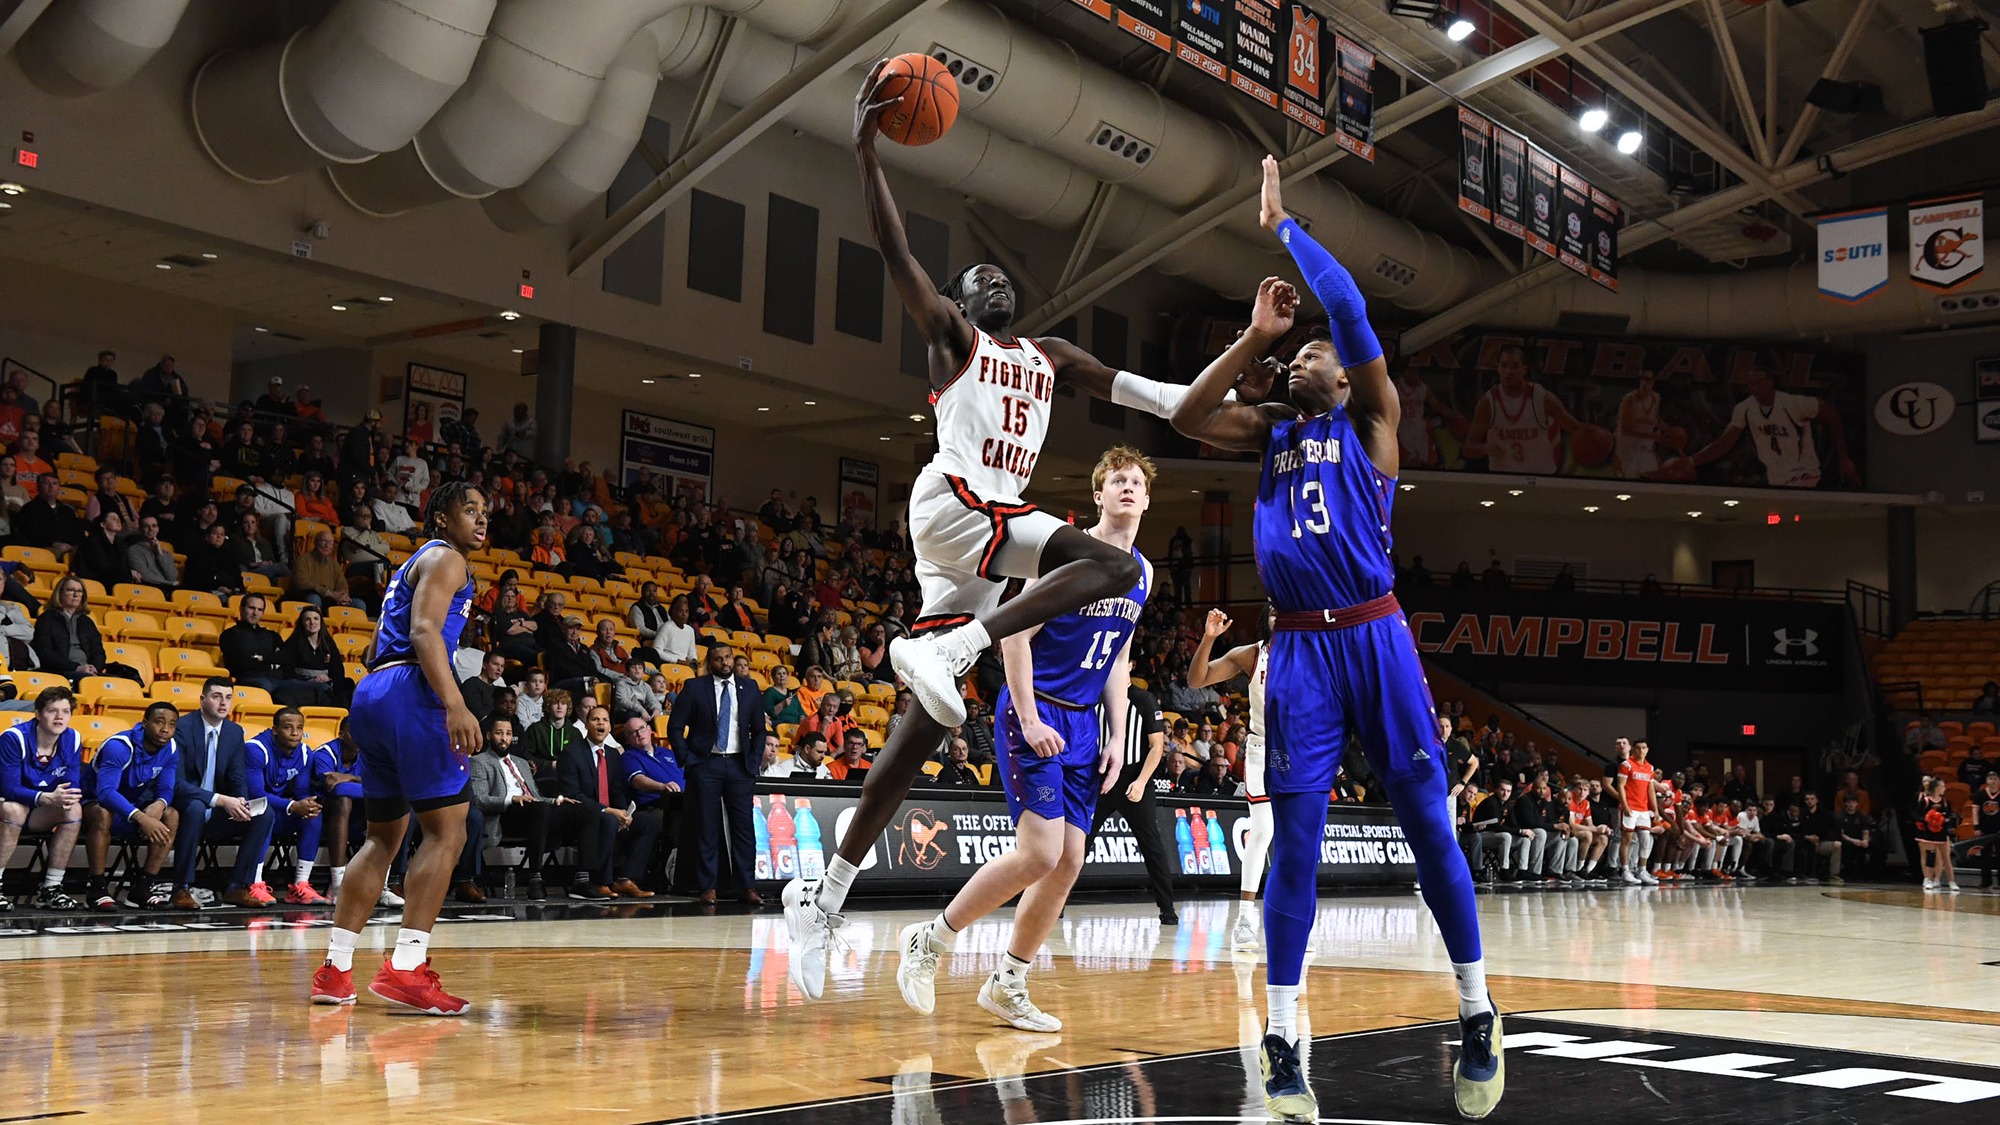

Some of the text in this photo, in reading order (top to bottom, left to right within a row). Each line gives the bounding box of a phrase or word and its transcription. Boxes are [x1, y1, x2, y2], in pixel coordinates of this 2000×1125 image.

[1134, 22, 1156, 41] 2019
[1239, 20, 1270, 48] WANDA
[1237, 33, 1273, 65] WATKINS
[1294, 33, 1315, 84] 34
[1238, 54, 1270, 80] 549 WINS
[19, 150, 38, 167] EXIT
[1913, 207, 1981, 226] CAMPBELL
[1824, 243, 1882, 263] SOUTH
[521, 284, 534, 299] EXIT
[1002, 396, 1031, 437] 15
[654, 426, 691, 440] southwest
[1408, 611, 1729, 664] CAMPBELL
[1080, 630, 1121, 670] 15
[1766, 658, 1827, 667] UNDER ARMOUR
[953, 814, 981, 831] THE
[982, 815, 1018, 832] OFFI
[1324, 823, 1405, 839] OFFICIAL SPORTS FU
[957, 835, 1144, 865] FIGH AME
[1318, 841, 1416, 865] IGHTING CAM
